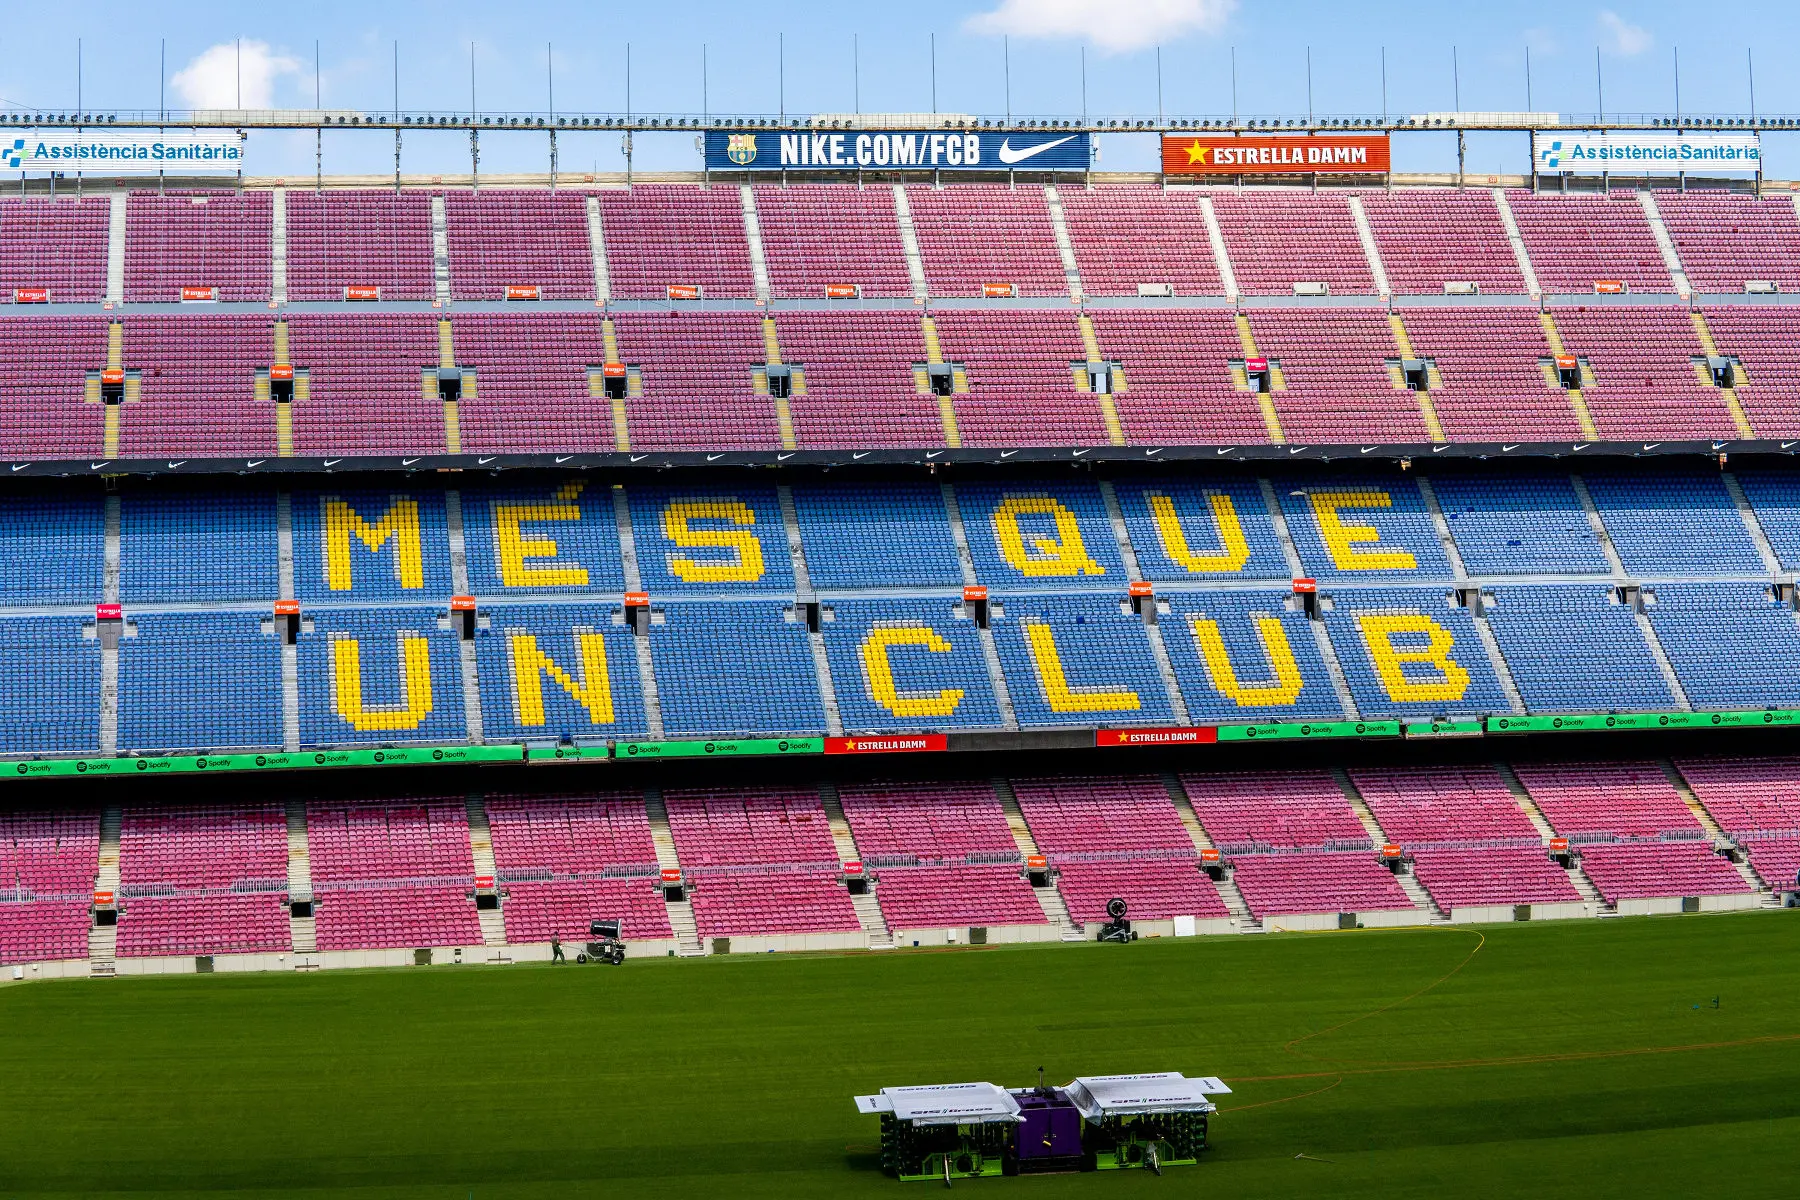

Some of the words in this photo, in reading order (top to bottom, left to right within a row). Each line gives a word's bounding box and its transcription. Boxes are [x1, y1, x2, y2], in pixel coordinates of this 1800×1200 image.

[34, 142, 147, 159] Assistència
[152, 143, 238, 159] Sanitària
[780, 134, 980, 165] NIKE.COM/FCB
[1572, 145, 1677, 160] Assistència
[1680, 144, 1759, 160] Sanitària
[1213, 147, 1304, 164] ESTRELLA
[1308, 147, 1366, 163] DAMM
[325, 482, 766, 591] MÉS
[993, 491, 1418, 578] QUE
[861, 613, 1471, 717] CLUB
[334, 632, 615, 731] UN
[1617, 718, 1637, 726] Spotify
[1670, 717, 1689, 725] Spotify
[1722, 715, 1741, 724] Spotify
[1774, 714, 1794, 723] Spotify
[1510, 720, 1531, 729] Spotify
[1564, 719, 1584, 728] Spotify
[1258, 728, 1278, 736] Spotify
[1312, 726, 1332, 735] Spotify
[1367, 725, 1387, 733] Spotify
[1130, 733, 1170, 742] ESTRELLA
[1172, 732, 1197, 741] DAMM
[639, 745, 661, 754] Spotify
[716, 744, 738, 752] Spotify
[790, 742, 812, 751] Spotify
[858, 742, 898, 750] ESTRELLA
[900, 741, 926, 749] DAMM
[327, 754, 349, 763] Spotify
[386, 752, 408, 761] Spotify
[444, 750, 467, 759] Spotify
[565, 750, 582, 758] Spotify
[148, 760, 171, 770] Spotify
[208, 759, 232, 768] Spotify
[268, 757, 290, 766] Spotify
[29, 764, 52, 773] Spotify
[88, 762, 111, 771] Spotify
